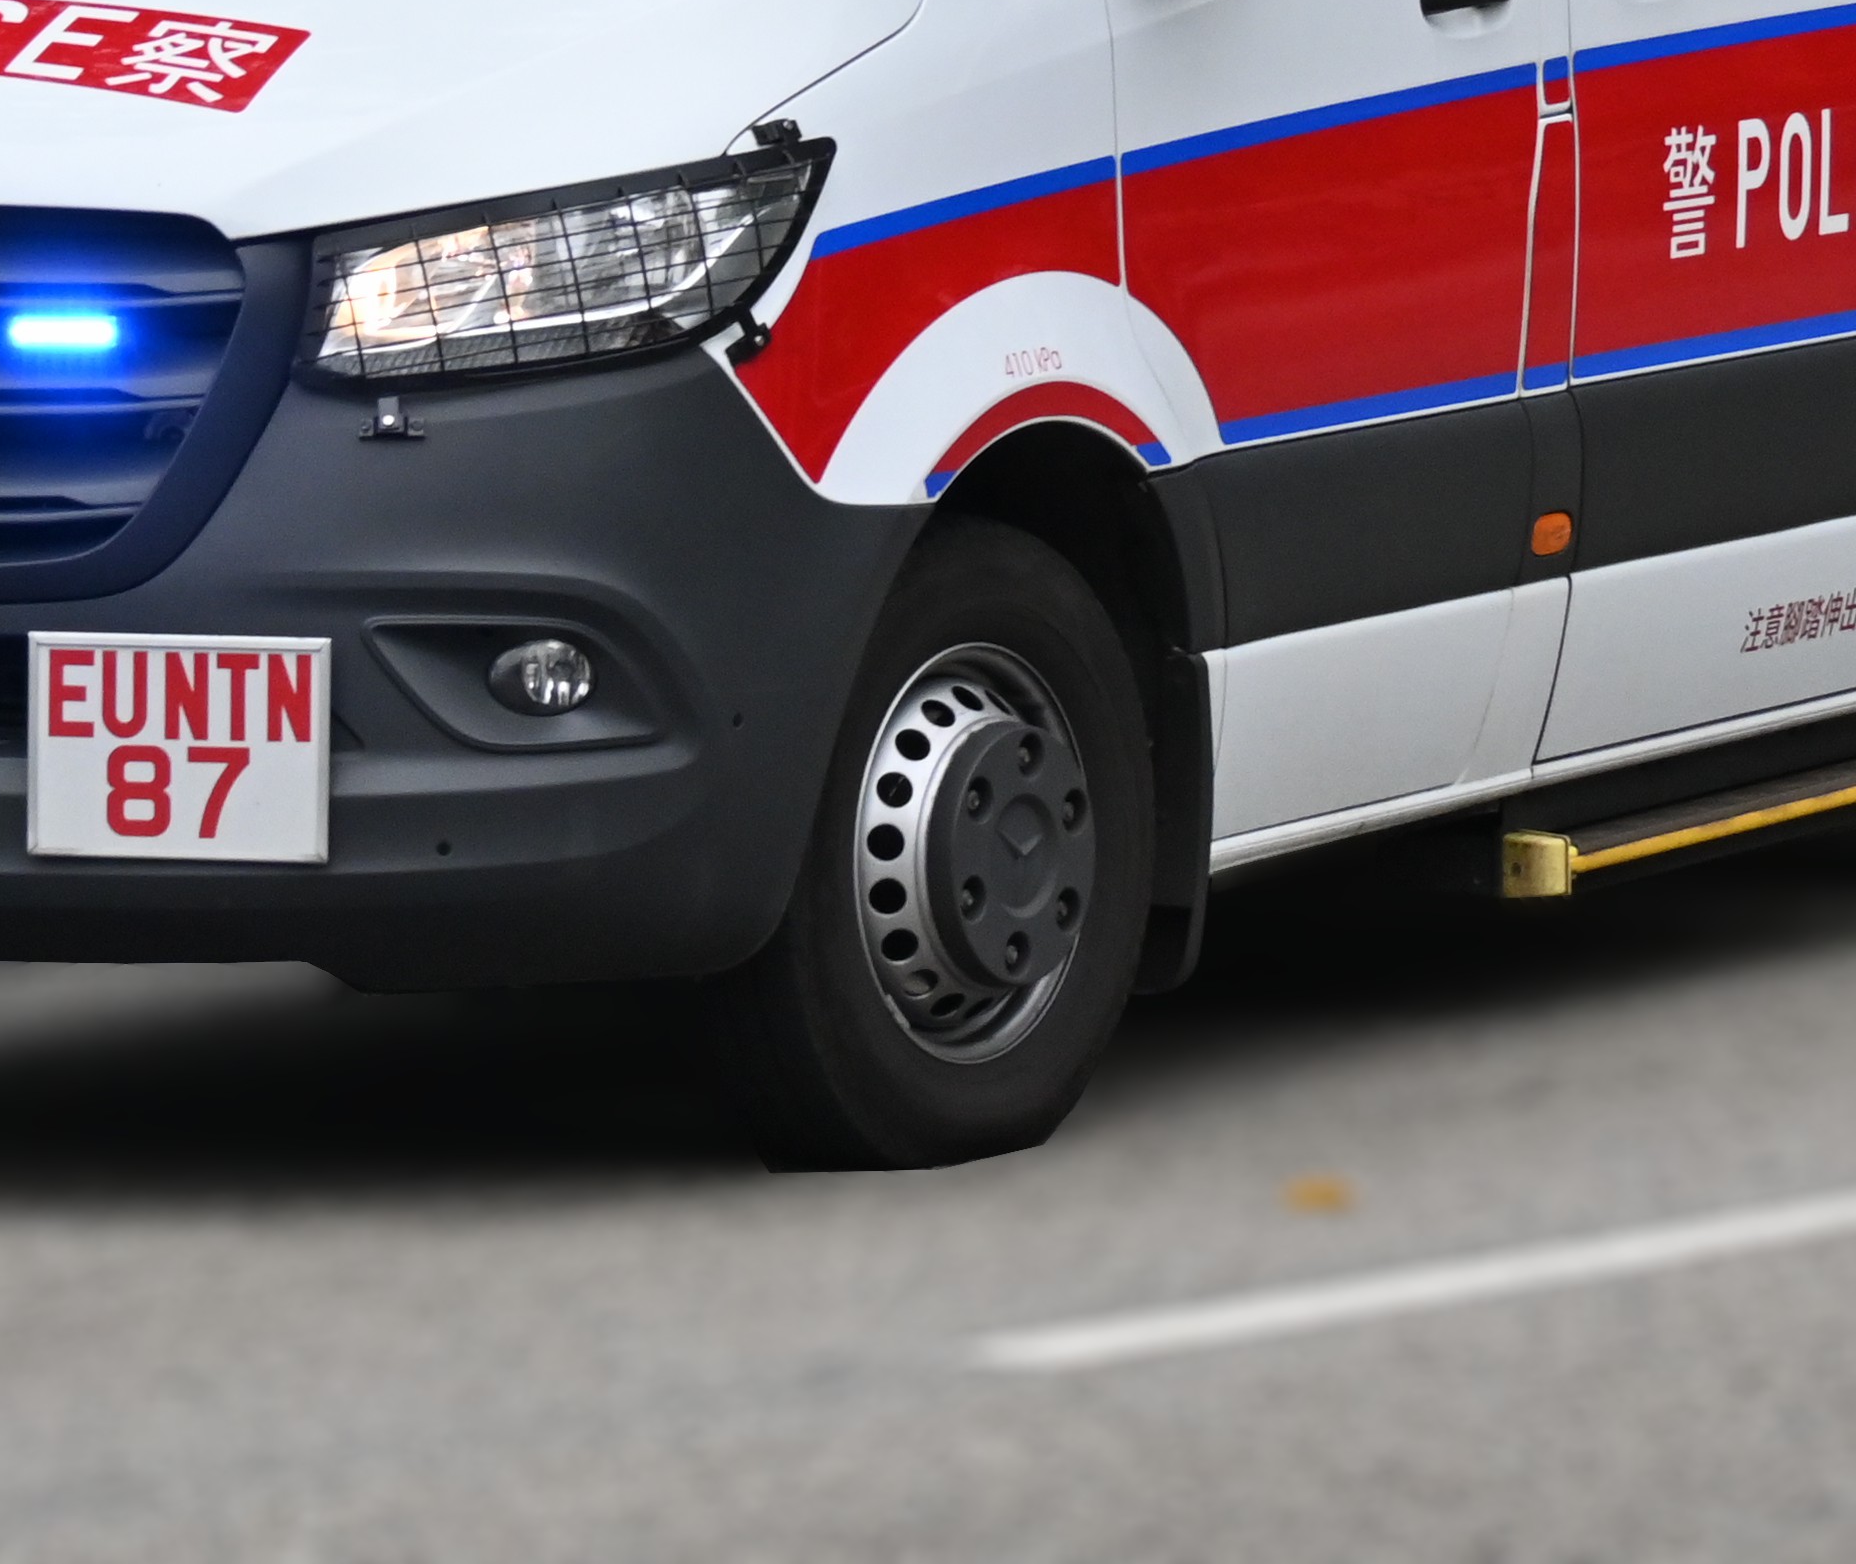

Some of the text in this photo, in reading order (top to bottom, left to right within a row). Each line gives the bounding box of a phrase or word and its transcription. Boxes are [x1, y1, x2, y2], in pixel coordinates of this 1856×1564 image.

[104, 21, 279, 103] 察
[1662, 124, 1717, 260] 警
[48, 649, 312, 743] EUNTN
[107, 744, 250, 838] 87
